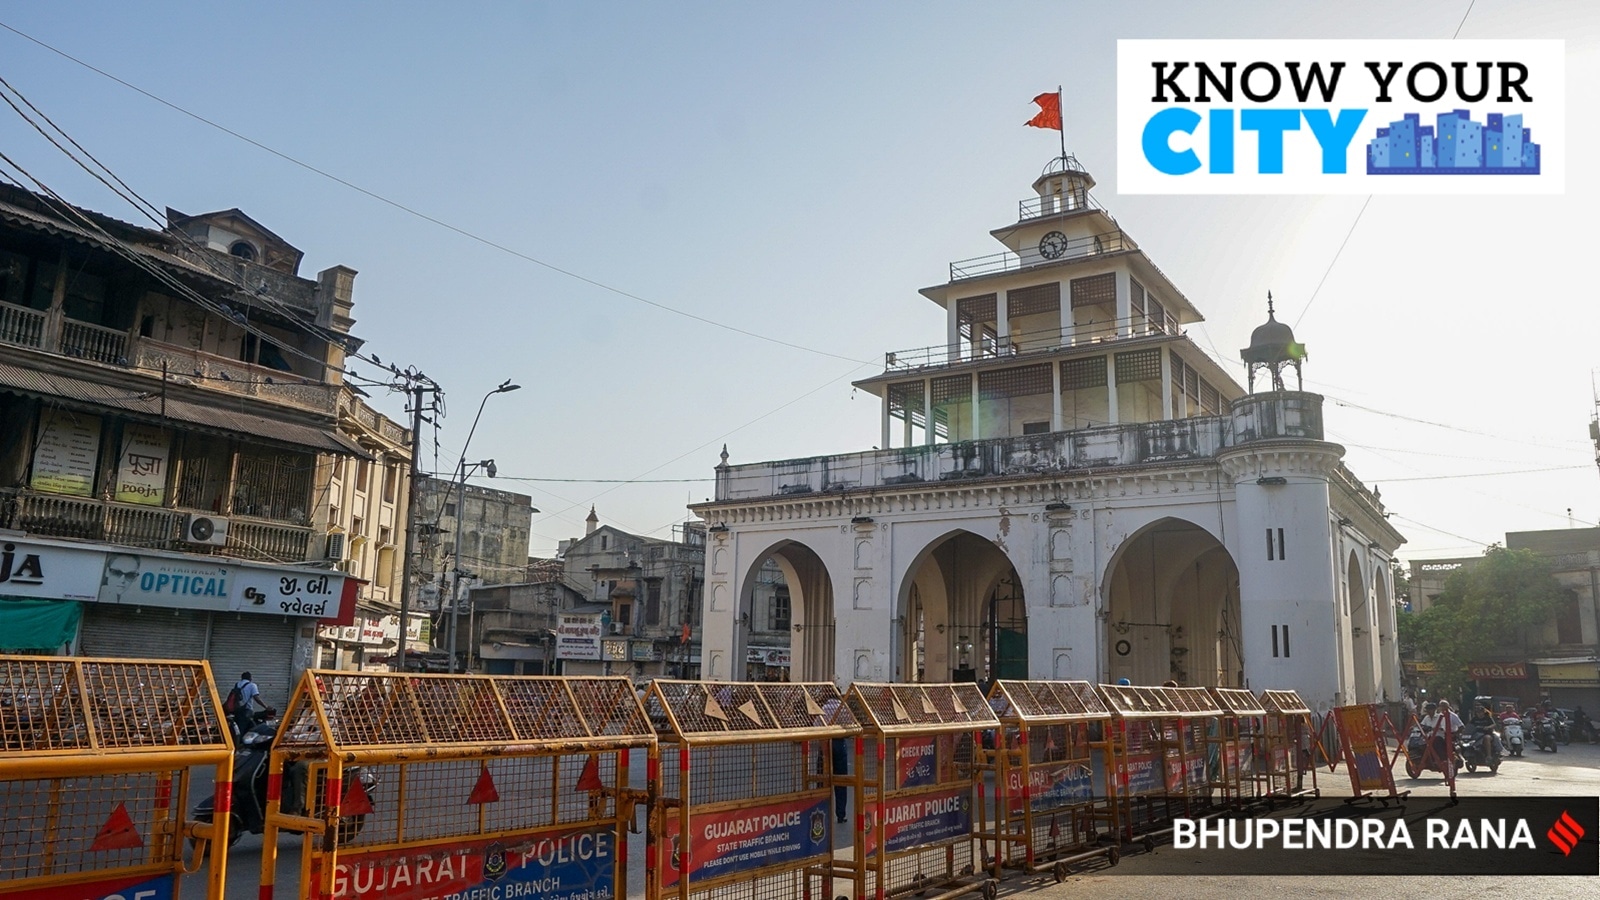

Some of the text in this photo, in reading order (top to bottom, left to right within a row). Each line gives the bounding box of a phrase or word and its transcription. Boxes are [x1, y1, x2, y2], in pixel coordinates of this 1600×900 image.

[128, 452, 163, 477] पूजा
[140, 571, 228, 597] OPTICAL
[280, 574, 332, 596] જી. બી.
[245, 586, 266, 605] GB
[280, 597, 328, 615] જવેલર્સ
[901, 744, 935, 759] CHECK POST
[1118, 761, 1138, 773] GARAT
[1010, 770, 1050, 790] GUARAT
[925, 796, 960, 817] POLICE
[704, 810, 801, 841] GUJARAT POLICE
[908, 821, 925, 832] TRAFFIC
[925, 818, 940, 829] BRANCH
[717, 832, 790, 853] STATE TRAFFIC BRANCH
[333, 832, 608, 898] GUJARAT POLICE
[704, 843, 801, 868] PLEASE DON'T USE MOBILE WHILE DRIVING
[505, 876, 560, 899] BRANCH
